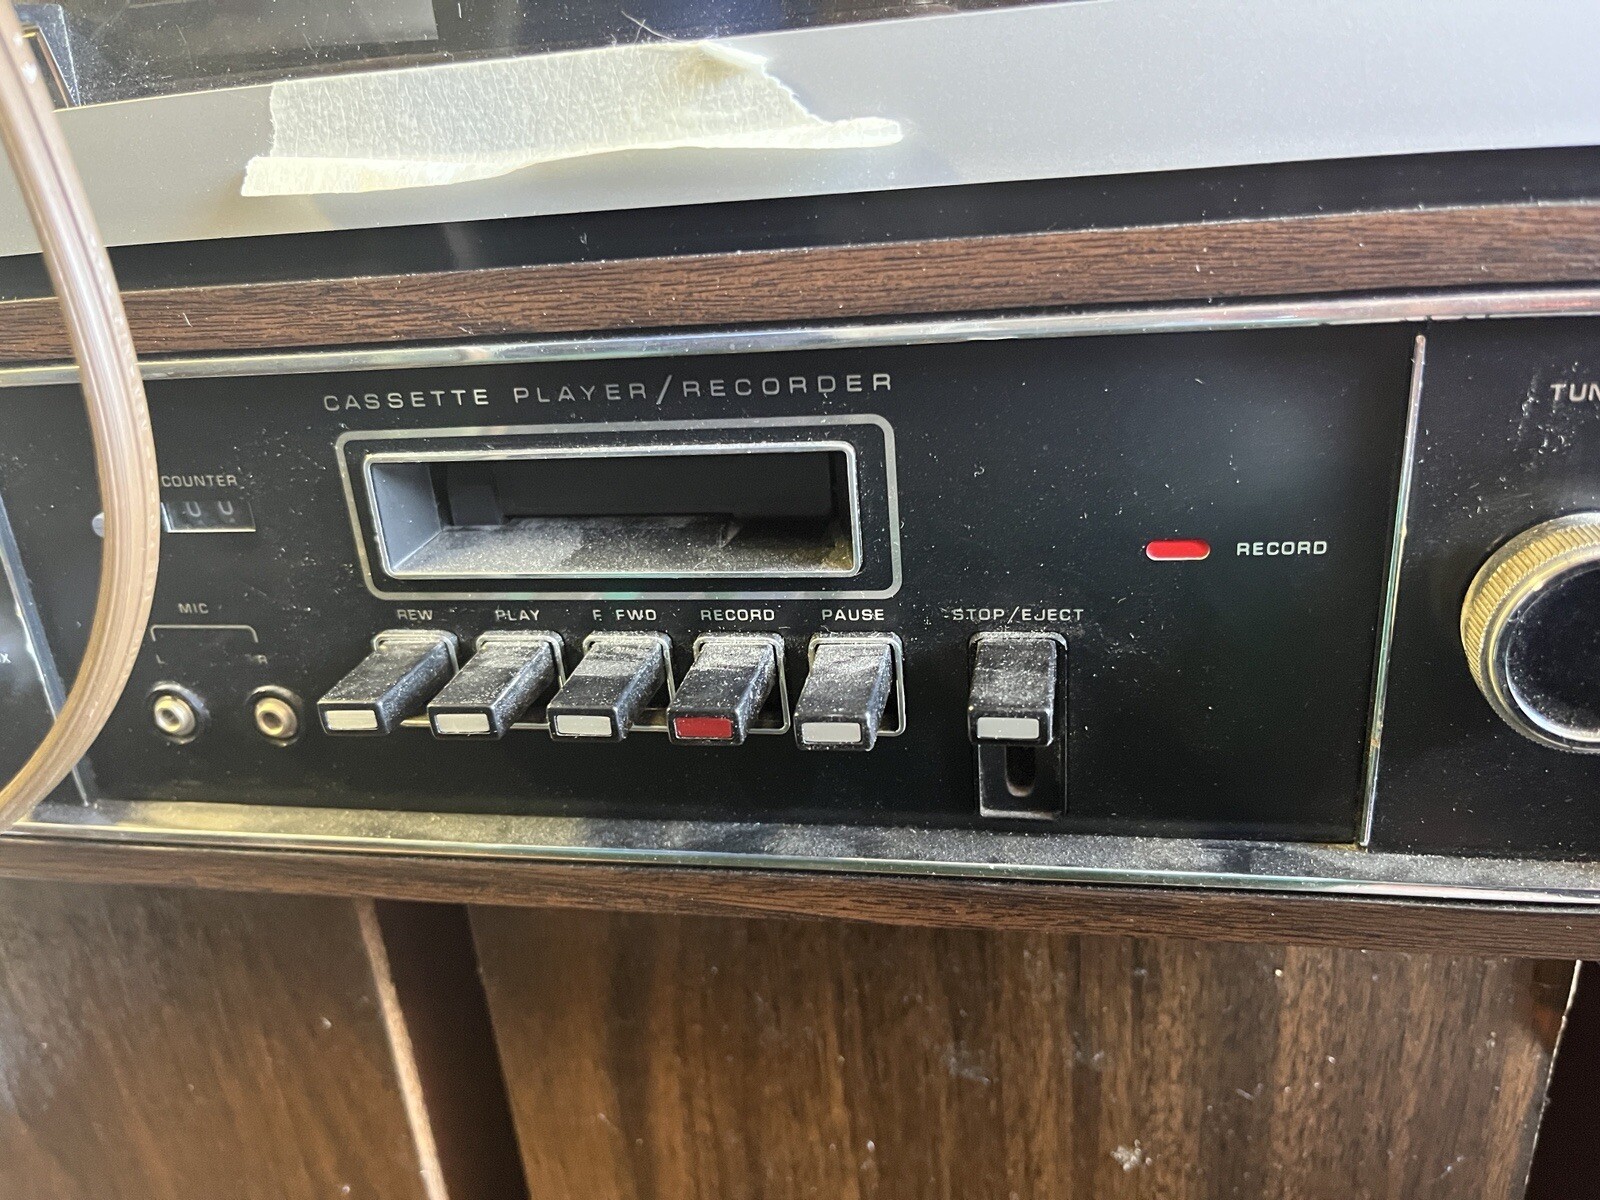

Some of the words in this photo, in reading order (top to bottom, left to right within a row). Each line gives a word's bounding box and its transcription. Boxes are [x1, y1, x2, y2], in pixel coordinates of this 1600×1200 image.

[323, 388, 489, 411] CASSETTE
[513, 374, 892, 405] PLAYER/RECORDER
[161, 475, 238, 488] COUNTER
[1236, 541, 1327, 556] RECORD
[177, 603, 209, 614] MIC
[952, 606, 1084, 622] STOP/EJECT
[396, 609, 433, 621] REW
[495, 609, 540, 621] PLAY
[615, 609, 657, 621] FWD
[700, 609, 775, 621] RECORD
[821, 609, 885, 621] PAUSE
